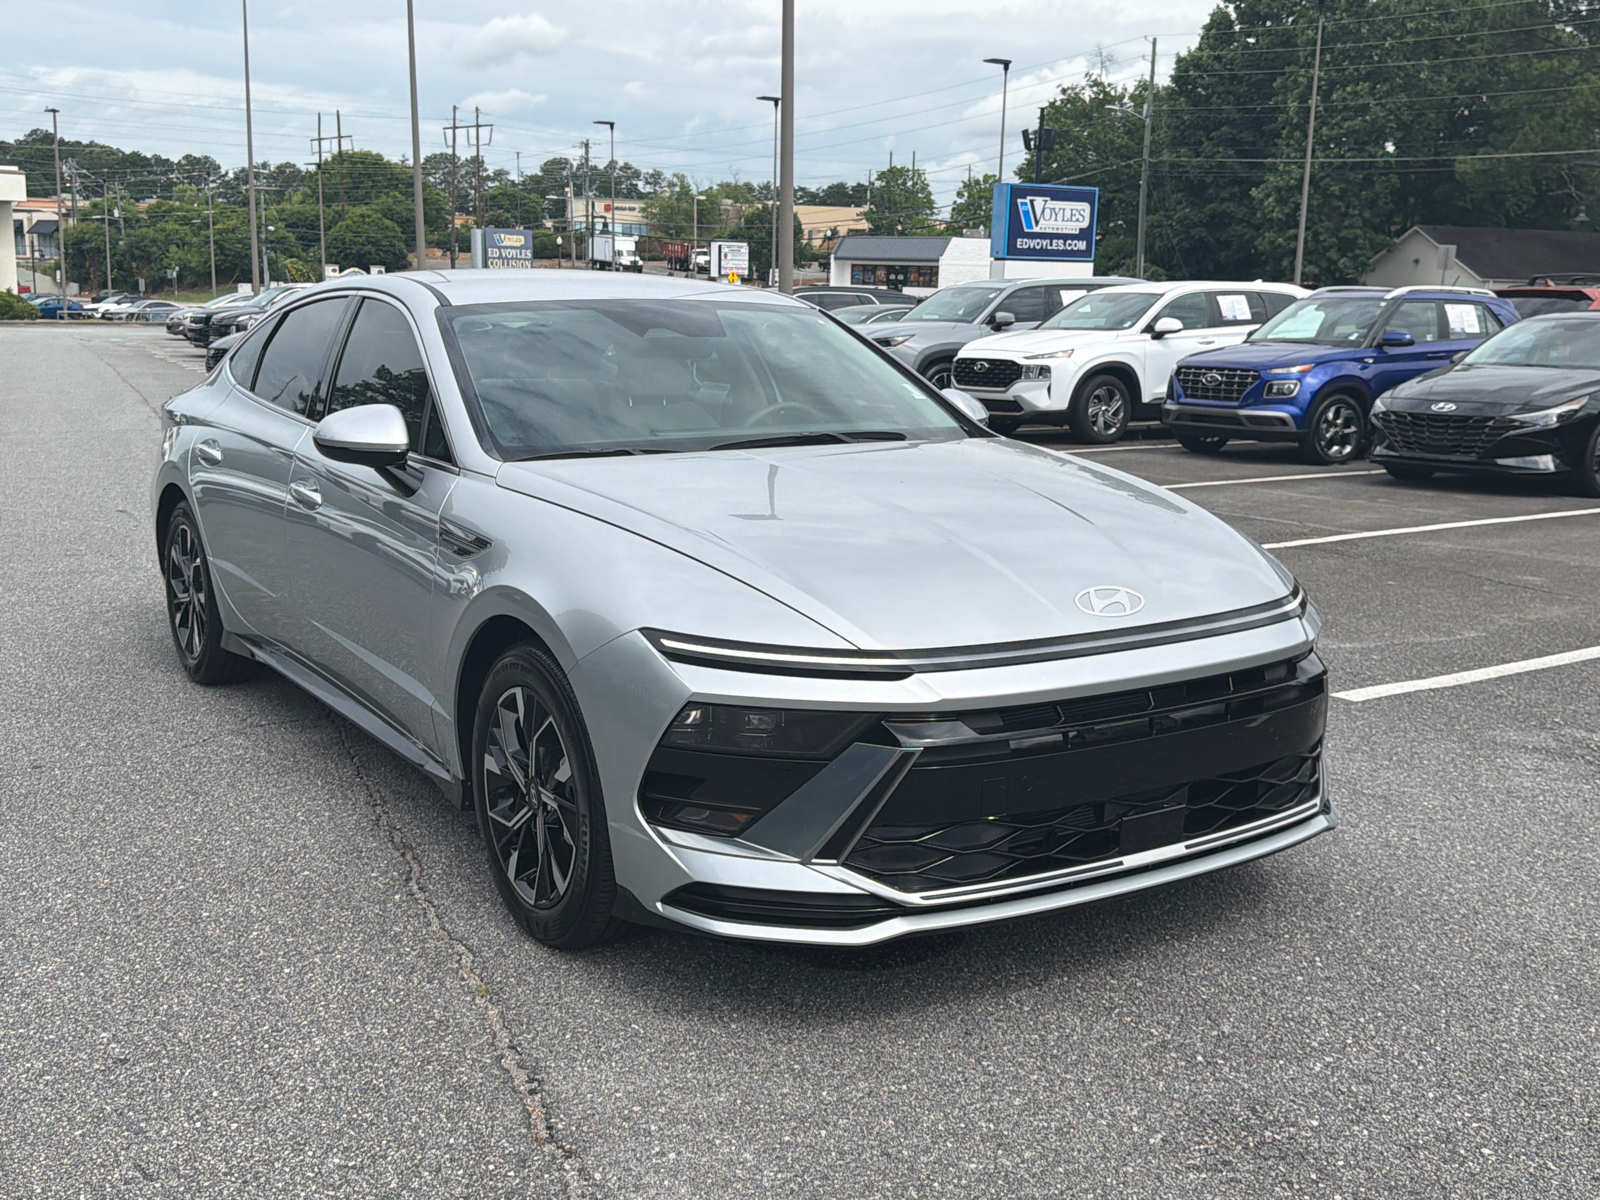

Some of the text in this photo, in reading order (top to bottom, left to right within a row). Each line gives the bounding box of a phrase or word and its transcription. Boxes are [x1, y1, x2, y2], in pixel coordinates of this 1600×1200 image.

[1029, 199, 1086, 227] VOYLES
[1016, 238, 1087, 250] EDVOYLES.COM
[488, 248, 531, 258] ED VOYLES
[488, 259, 531, 268] COLLISION
